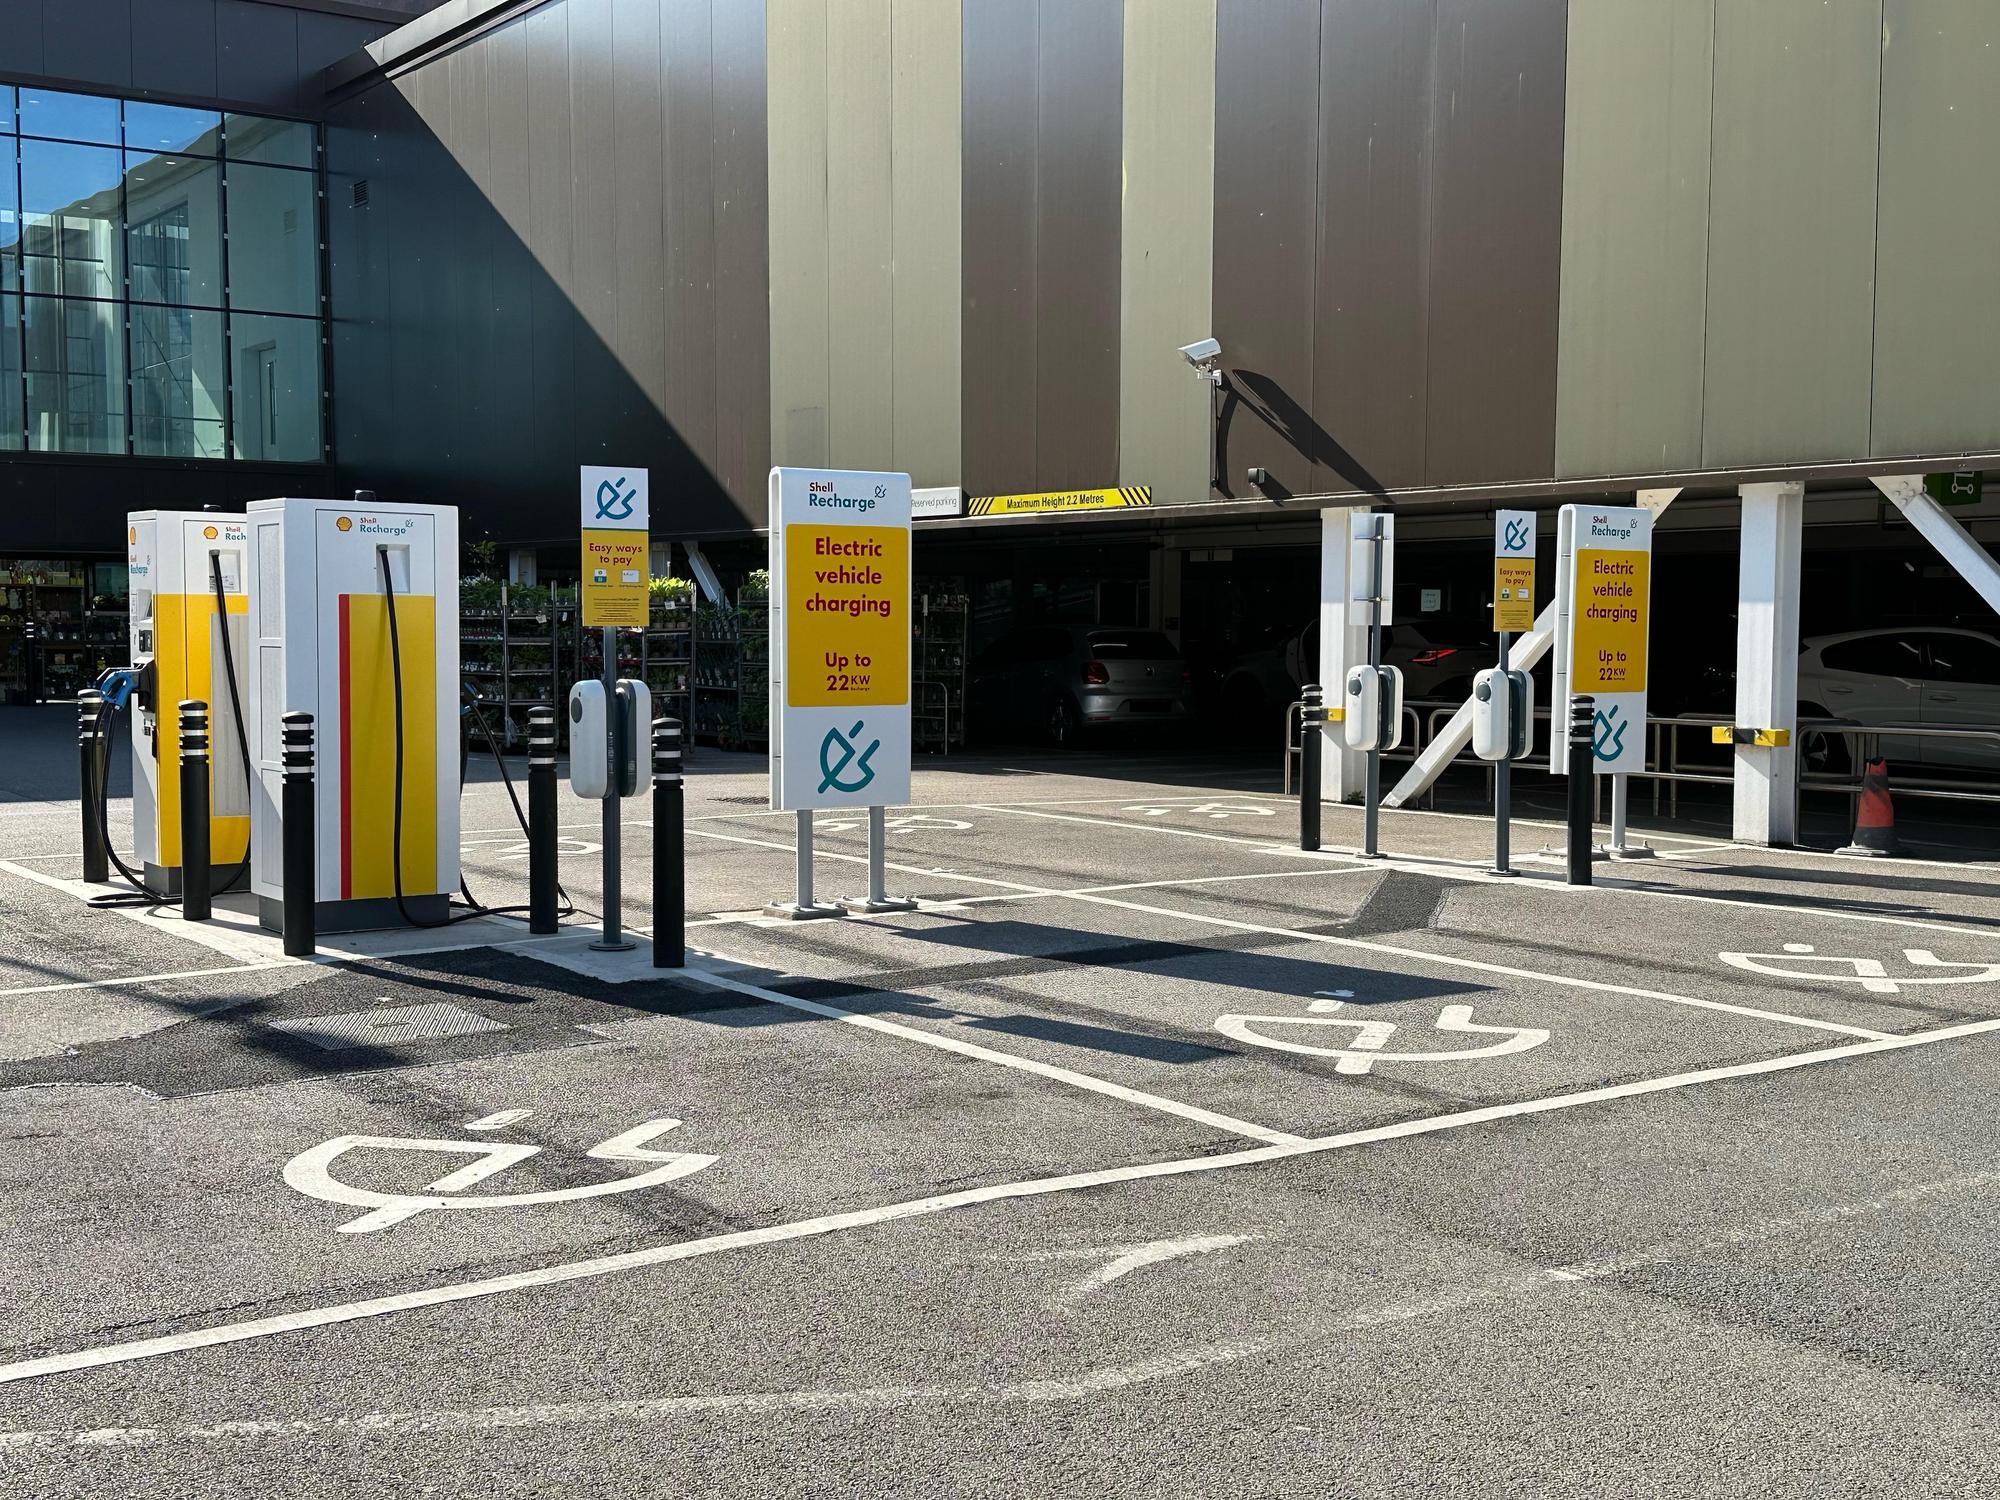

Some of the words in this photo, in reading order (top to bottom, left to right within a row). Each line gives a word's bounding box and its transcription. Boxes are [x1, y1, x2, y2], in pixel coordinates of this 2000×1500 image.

[809, 482, 833, 492] Shell
[809, 493, 876, 512] Recharge
[1007, 498, 1040, 508] Maximum
[1041, 496, 1065, 508] Height
[1066, 495, 1077, 505] 2.2
[1079, 494, 1105, 504] Metres
[1592, 515, 1608, 524] Shell
[360, 524, 406, 536] Recharge
[1591, 525, 1631, 540] Recharge
[589, 542, 612, 554] Easy
[616, 545, 643, 555] ways
[815, 536, 883, 556] Electric
[600, 555, 610, 563] to
[613, 556, 632, 566] pay
[1594, 559, 1634, 575] Electric
[815, 564, 882, 584] vehicle
[1499, 567, 1514, 577] Easy
[1513, 578, 1525, 586] pay
[1592, 581, 1633, 597] vehicle
[806, 592, 891, 617] charging
[1586, 602, 1637, 623] charging
[825, 652, 849, 672] Up
[854, 653, 872, 667] to
[1599, 649, 1613, 665] Up
[1616, 651, 1627, 662] to
[1599, 667, 1613, 681] 22
[826, 674, 849, 691] 22
[850, 674, 871, 685] KW
